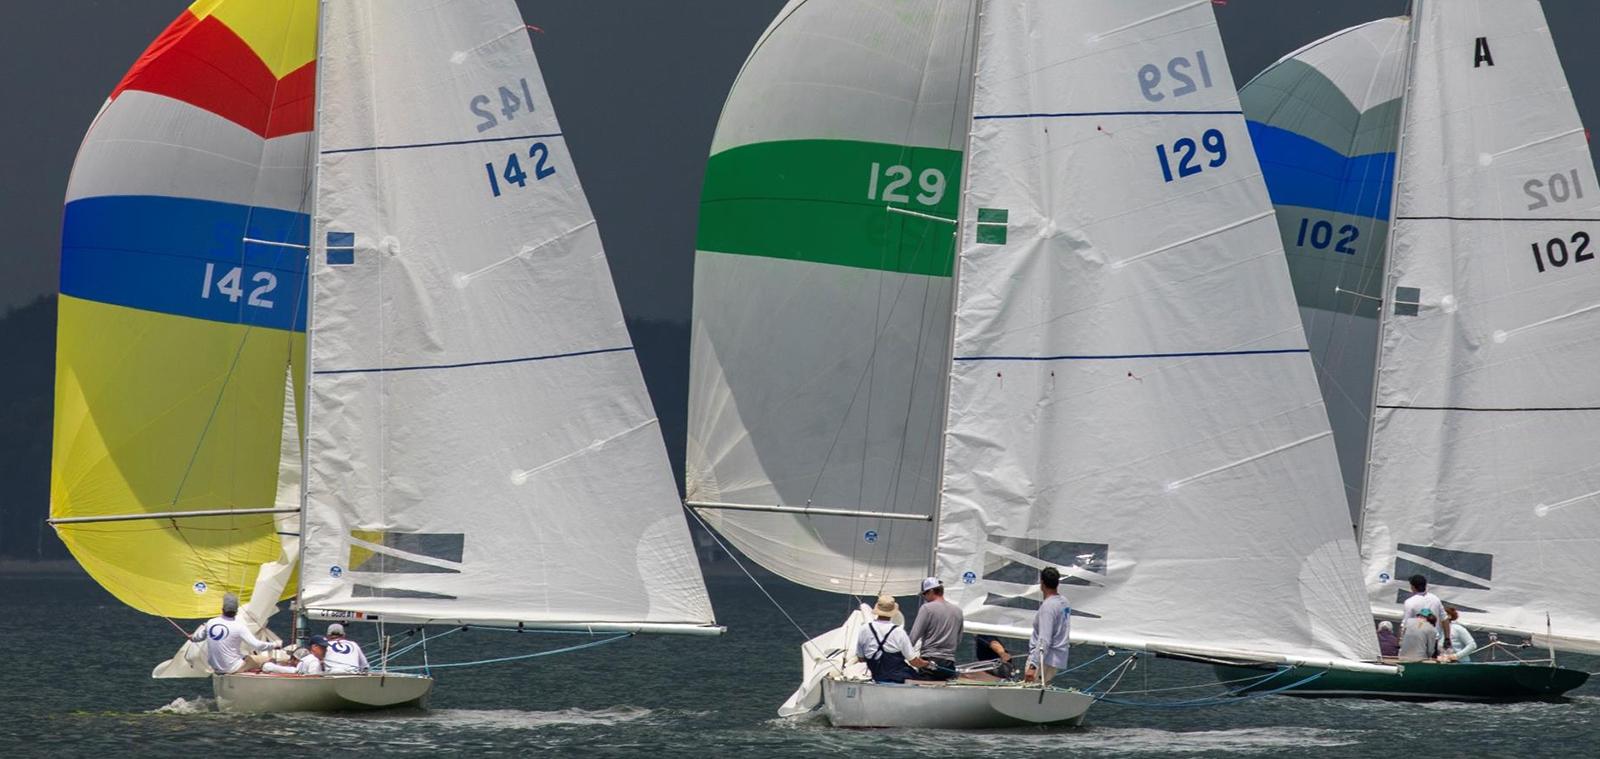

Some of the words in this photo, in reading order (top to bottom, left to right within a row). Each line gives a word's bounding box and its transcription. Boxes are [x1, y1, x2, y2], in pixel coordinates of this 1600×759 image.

[1474, 37, 1495, 68] A
[485, 142, 556, 197] 142
[1156, 128, 1227, 182] 129
[867, 162, 946, 206] 129
[1297, 218, 1359, 255] 102
[1531, 231, 1595, 273] 102
[201, 262, 278, 309] 142
